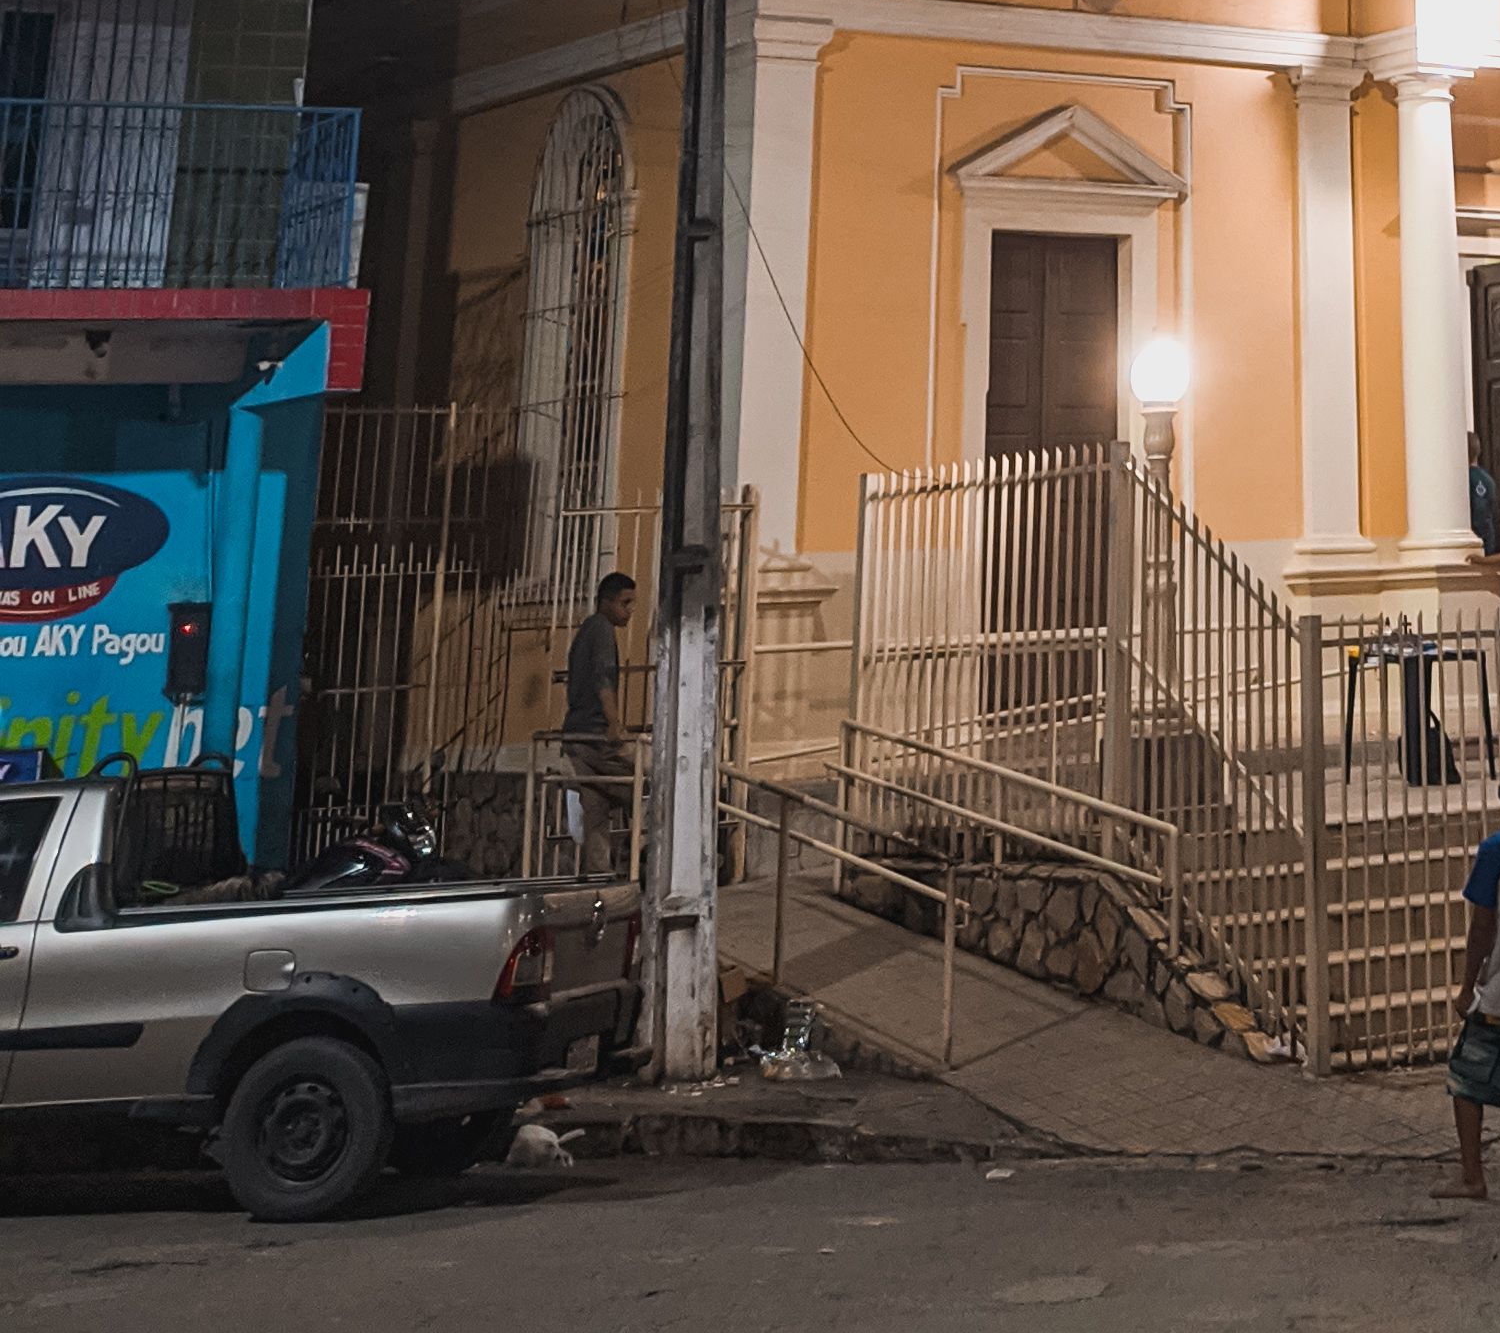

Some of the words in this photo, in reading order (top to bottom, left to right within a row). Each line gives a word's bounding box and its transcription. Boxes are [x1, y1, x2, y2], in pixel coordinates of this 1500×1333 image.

[0, 504, 106, 568] KY
[0, 590, 20, 606] AS
[31, 590, 55, 604] ON
[68, 581, 101, 601] LINE
[0, 636, 27, 657] ou
[32, 624, 86, 657] AKY
[91, 624, 165, 666] Pagou
